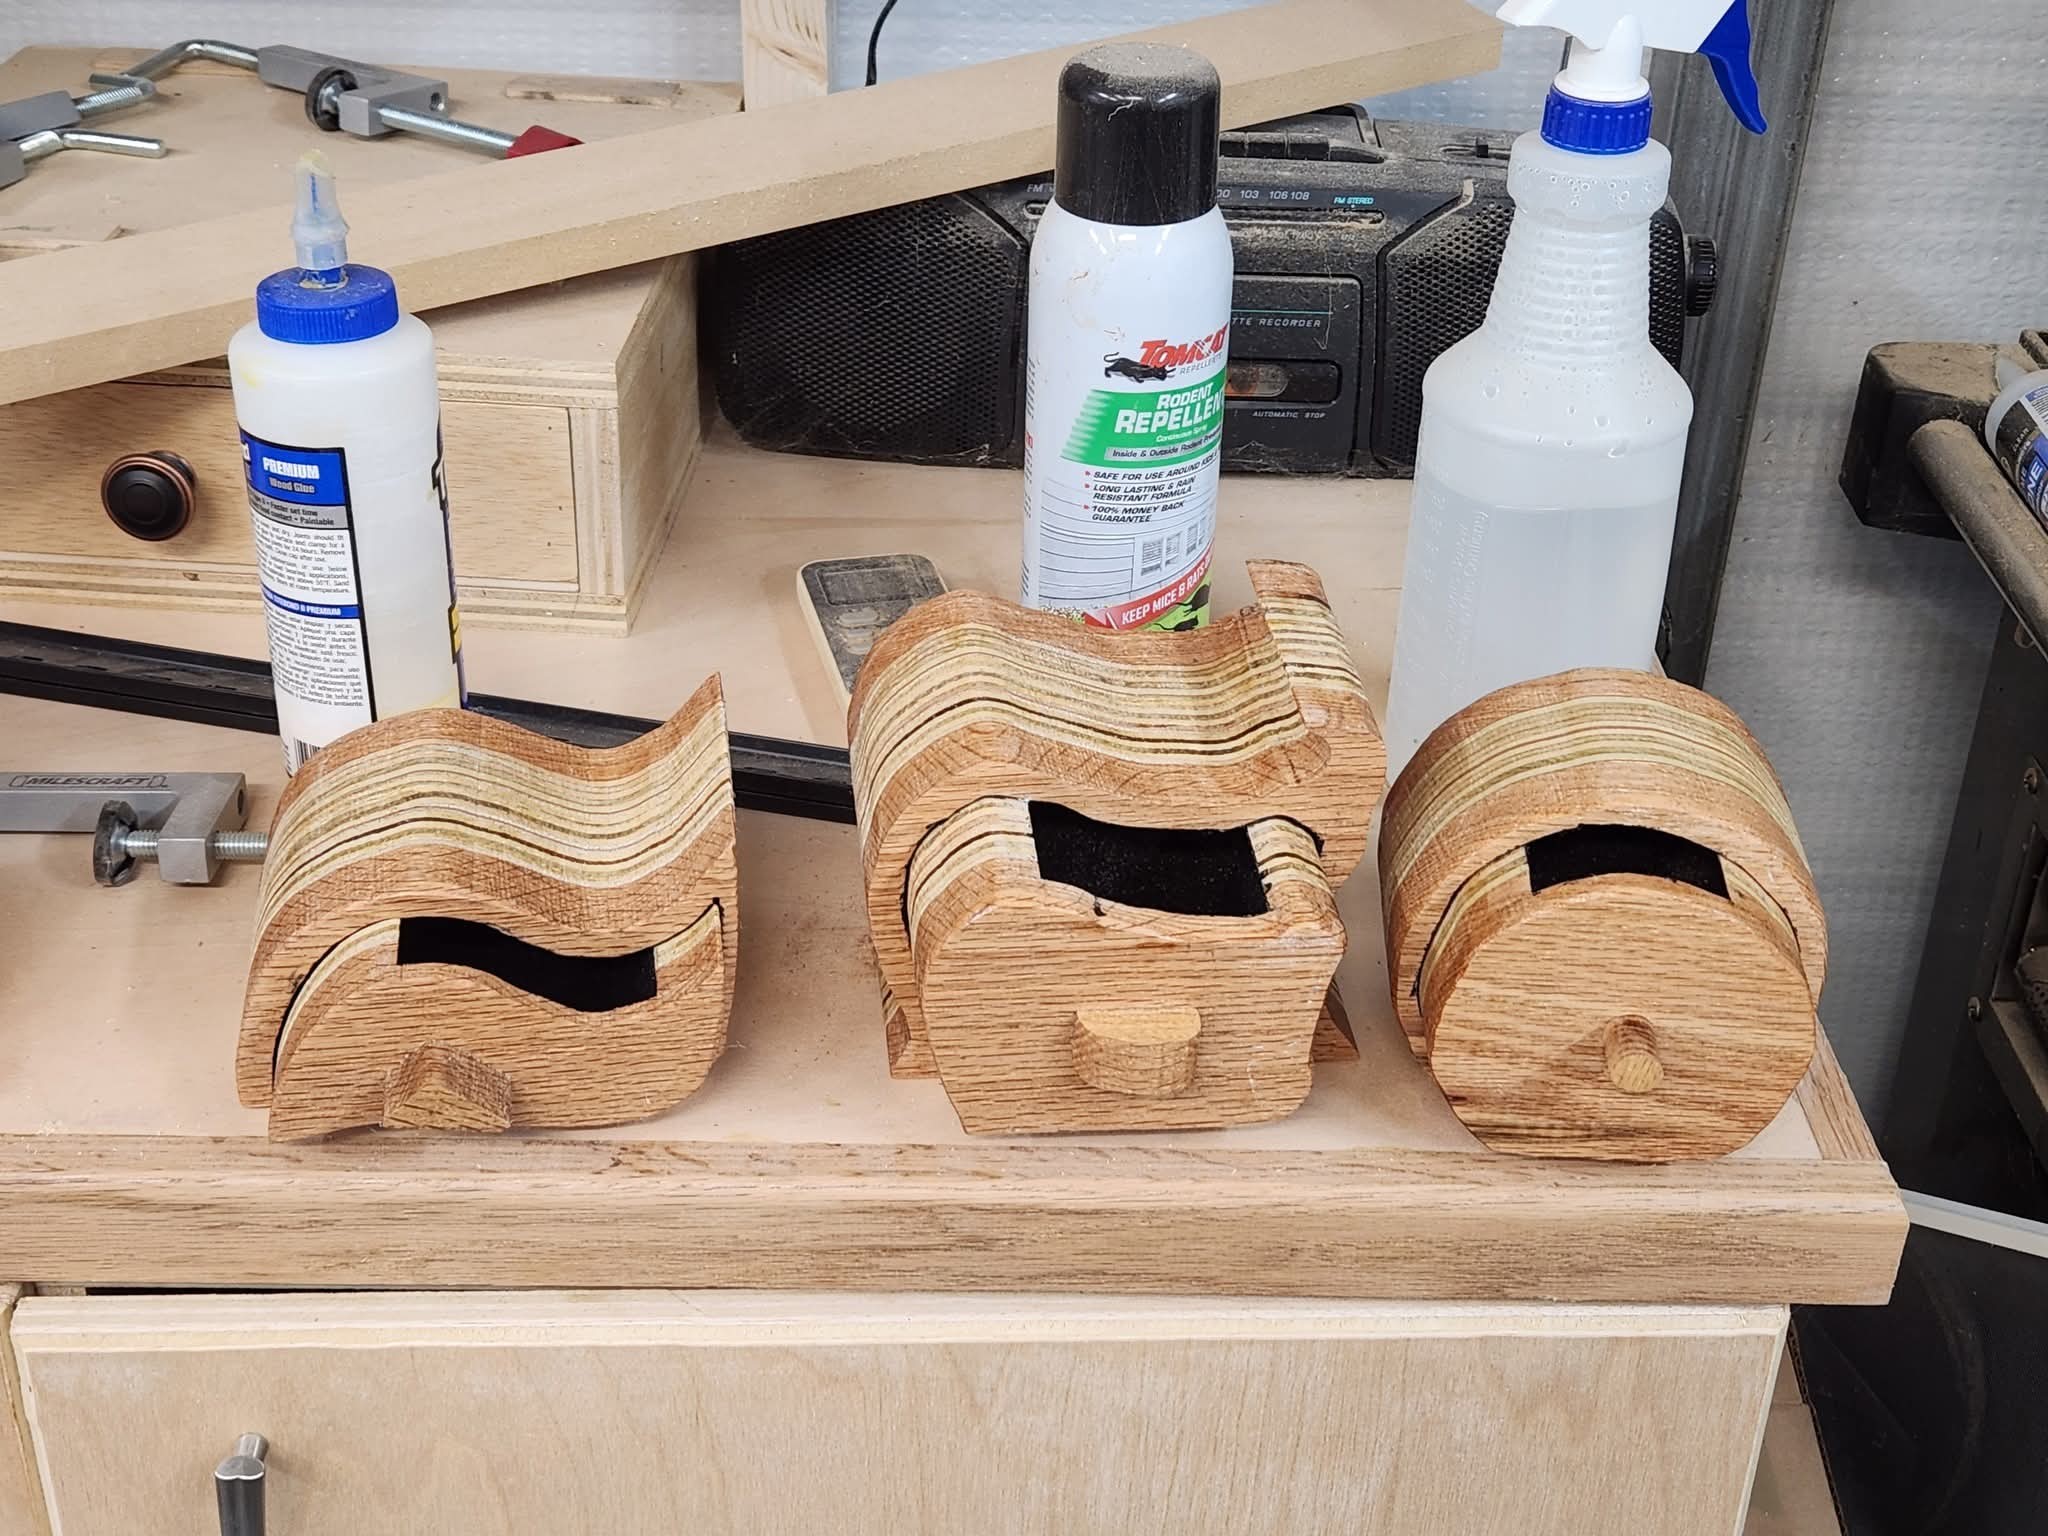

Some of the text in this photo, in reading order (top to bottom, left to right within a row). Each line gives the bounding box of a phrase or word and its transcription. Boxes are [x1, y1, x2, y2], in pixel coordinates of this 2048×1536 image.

[1239, 190, 1259, 198] 103
[1269, 191, 1288, 199] 106
[1291, 192, 1310, 200] 108
[1347, 197, 1374, 205] STEREO
[1259, 318, 1321, 327] RECORDER
[1157, 382, 1213, 409] RODENT
[1112, 449, 1137, 458] Inside
[1150, 446, 1178, 457] Outside
[263, 456, 320, 479] PREMIUM
[1093, 471, 1119, 479] SAFE
[1167, 462, 1200, 477] AROUND
[269, 477, 315, 494] Wood Glue
[1093, 484, 1121, 493] LONG
[1124, 484, 1165, 493] LASTING
[1176, 475, 1196, 488] RAIN
[1093, 486, 1192, 501] RESISTANT FORMULA
[1092, 501, 1185, 514] 100% MONEY BACK
[300, 516, 335, 526] Paintable
[1092, 513, 1152, 522] GUARANTEE
[1122, 605, 1150, 625] KEEP
[1152, 589, 1177, 613] MICE
[26, 776, 150, 786] MILESCRAFT
